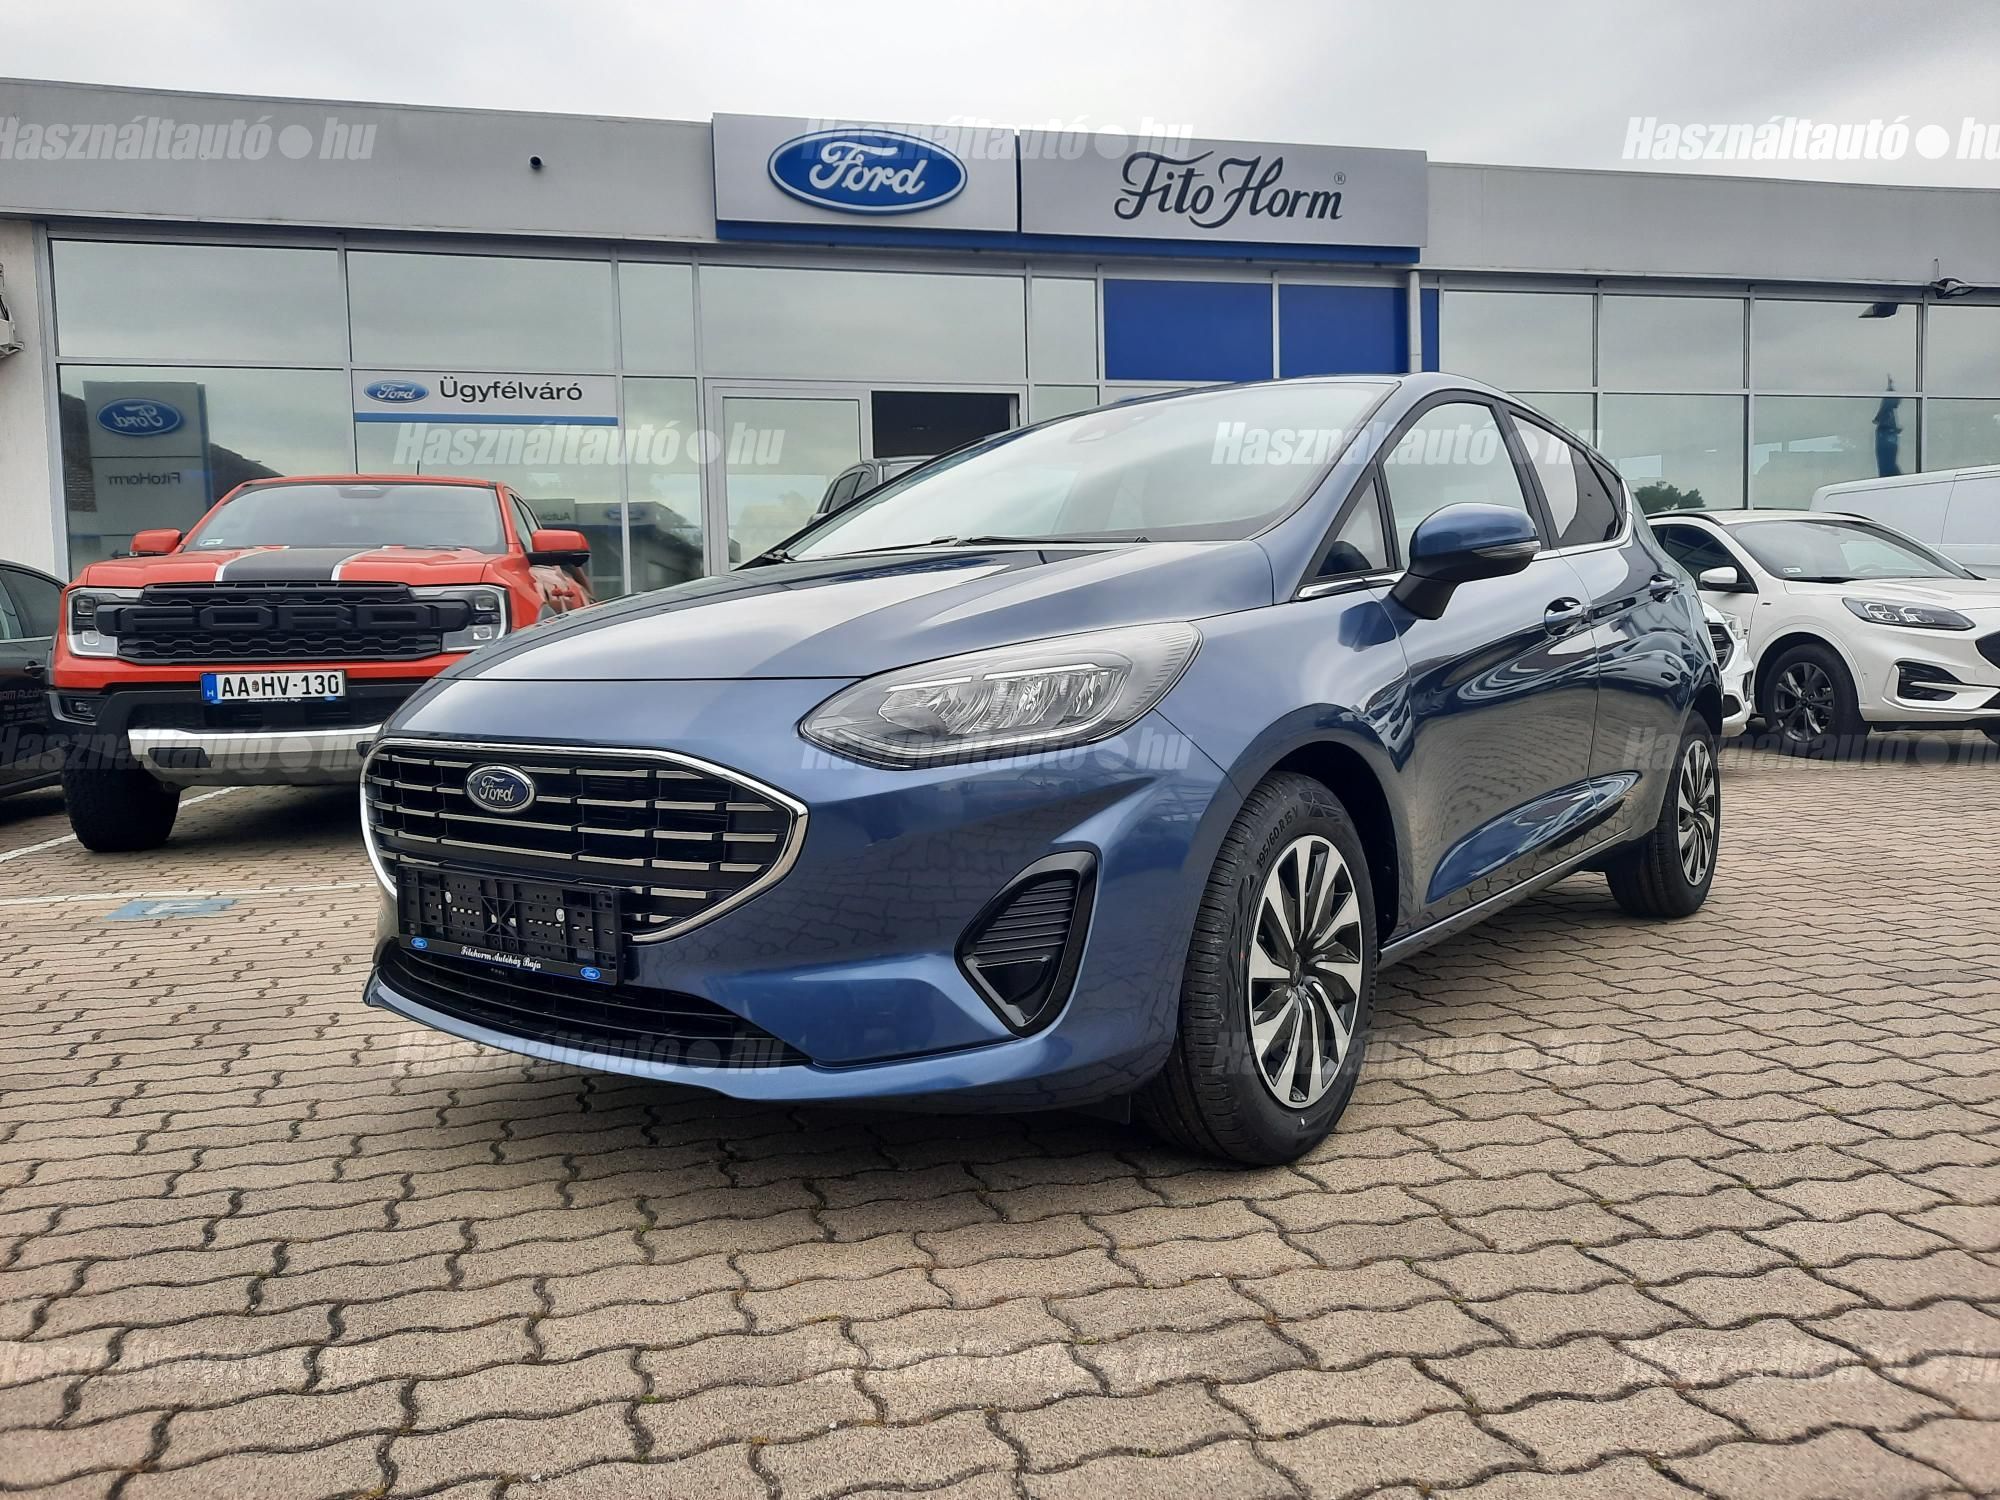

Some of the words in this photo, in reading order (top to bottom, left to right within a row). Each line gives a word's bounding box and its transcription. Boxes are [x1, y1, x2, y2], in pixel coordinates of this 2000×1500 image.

[809, 140, 929, 196] Ford
[375, 384, 416, 400] Ford
[439, 375, 584, 404] Ügyfélváró
[479, 775, 515, 802] Ford
